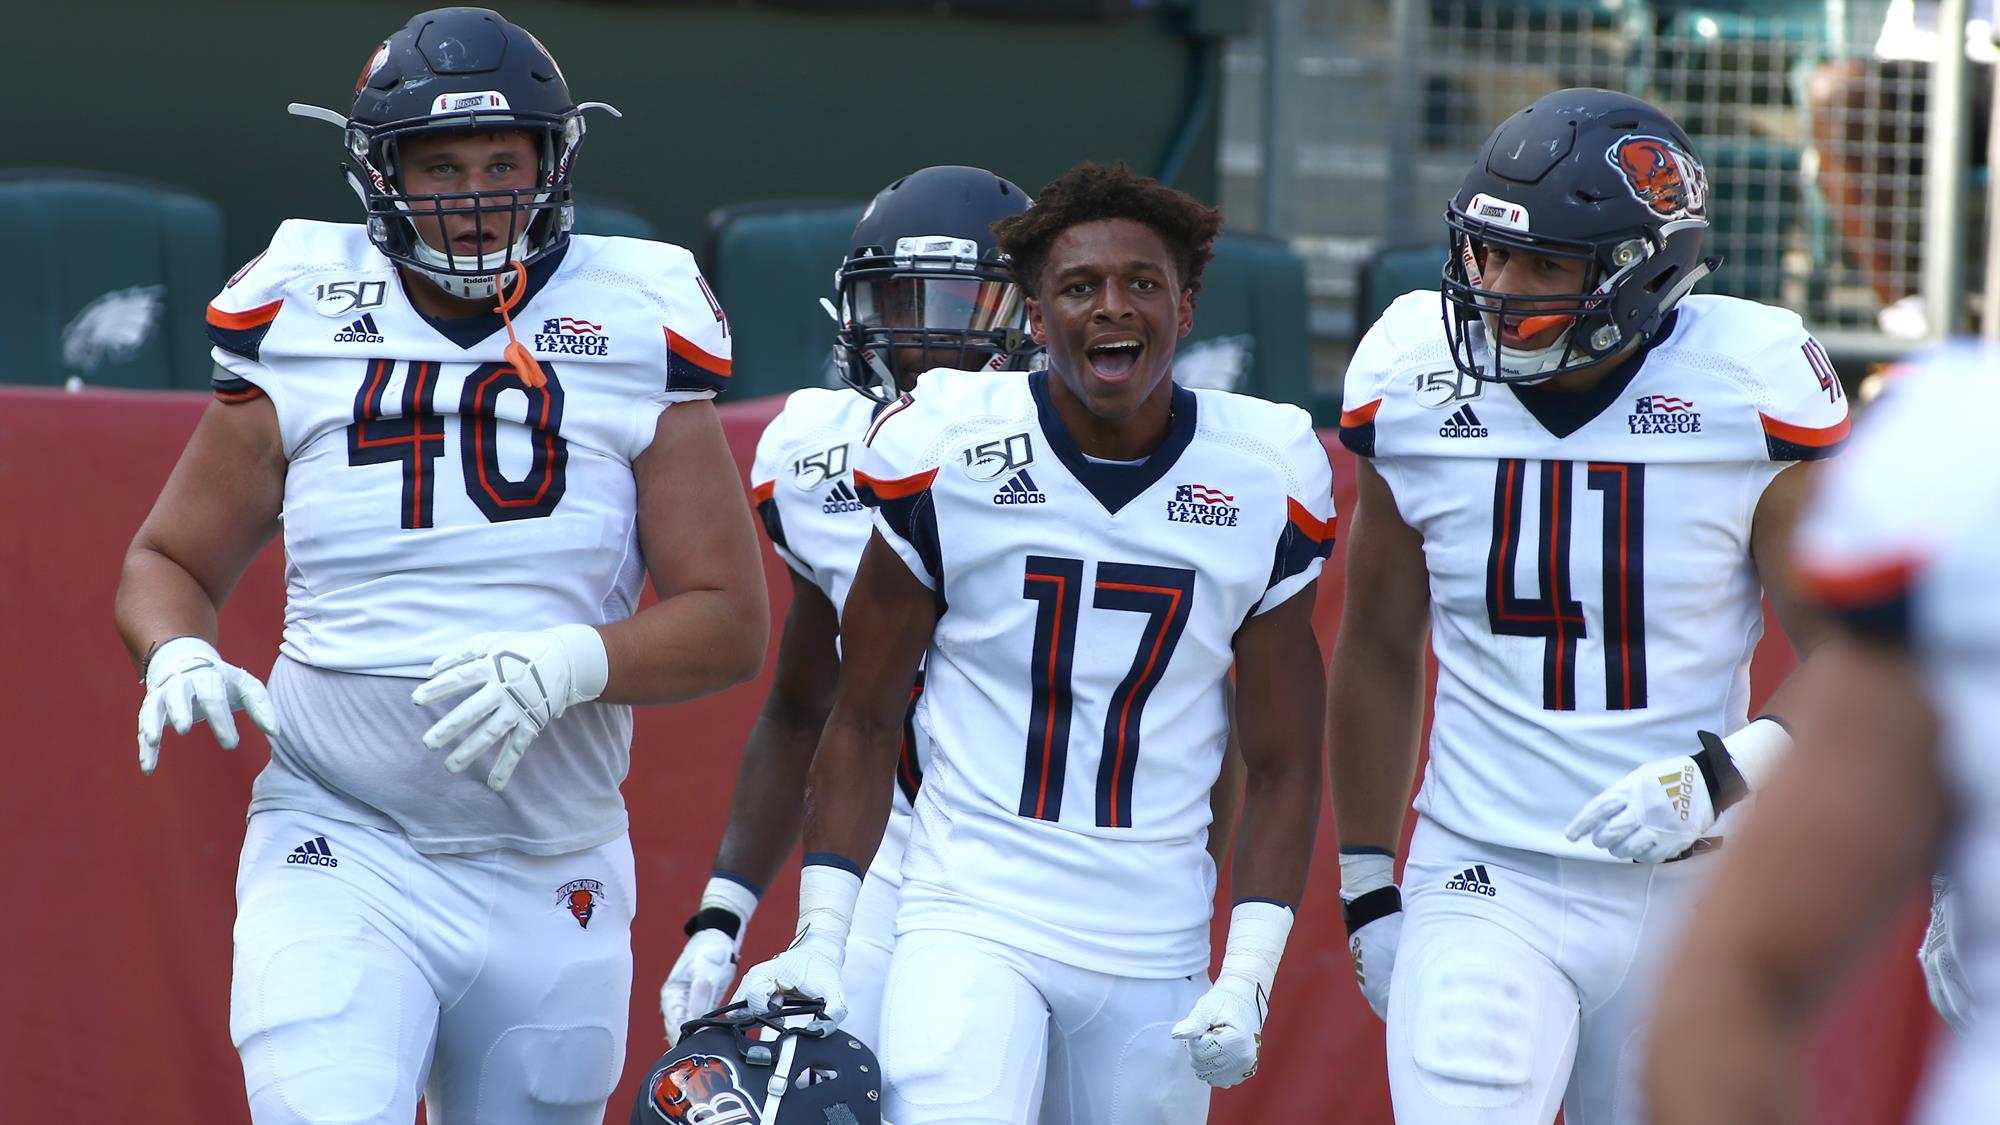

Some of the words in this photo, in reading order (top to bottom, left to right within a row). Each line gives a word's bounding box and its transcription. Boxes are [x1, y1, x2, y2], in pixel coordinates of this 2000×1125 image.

[463, 276, 493, 284] Riddell
[316, 280, 386, 314] 150
[333, 330, 385, 343] adidas
[534, 334, 609, 346] PATRIOT
[535, 343, 608, 356] LEAGUE
[1628, 413, 1701, 424] PATRIOT
[1439, 425, 1489, 438] adidas
[1630, 422, 1702, 435] LEAGUE
[347, 358, 568, 529] 40
[963, 432, 1034, 478] 150
[793, 443, 849, 490] 150
[993, 491, 1046, 504] adidas
[822, 500, 864, 514] adidas
[1166, 501, 1240, 517] PATRIOT
[1167, 511, 1238, 527] LEAGUE
[1486, 457, 1648, 711] 41
[1018, 555, 1196, 828] 17
[1680, 765, 1694, 821] adidas
[286, 852, 338, 868] adidas
[1445, 879, 1497, 897] adidas
